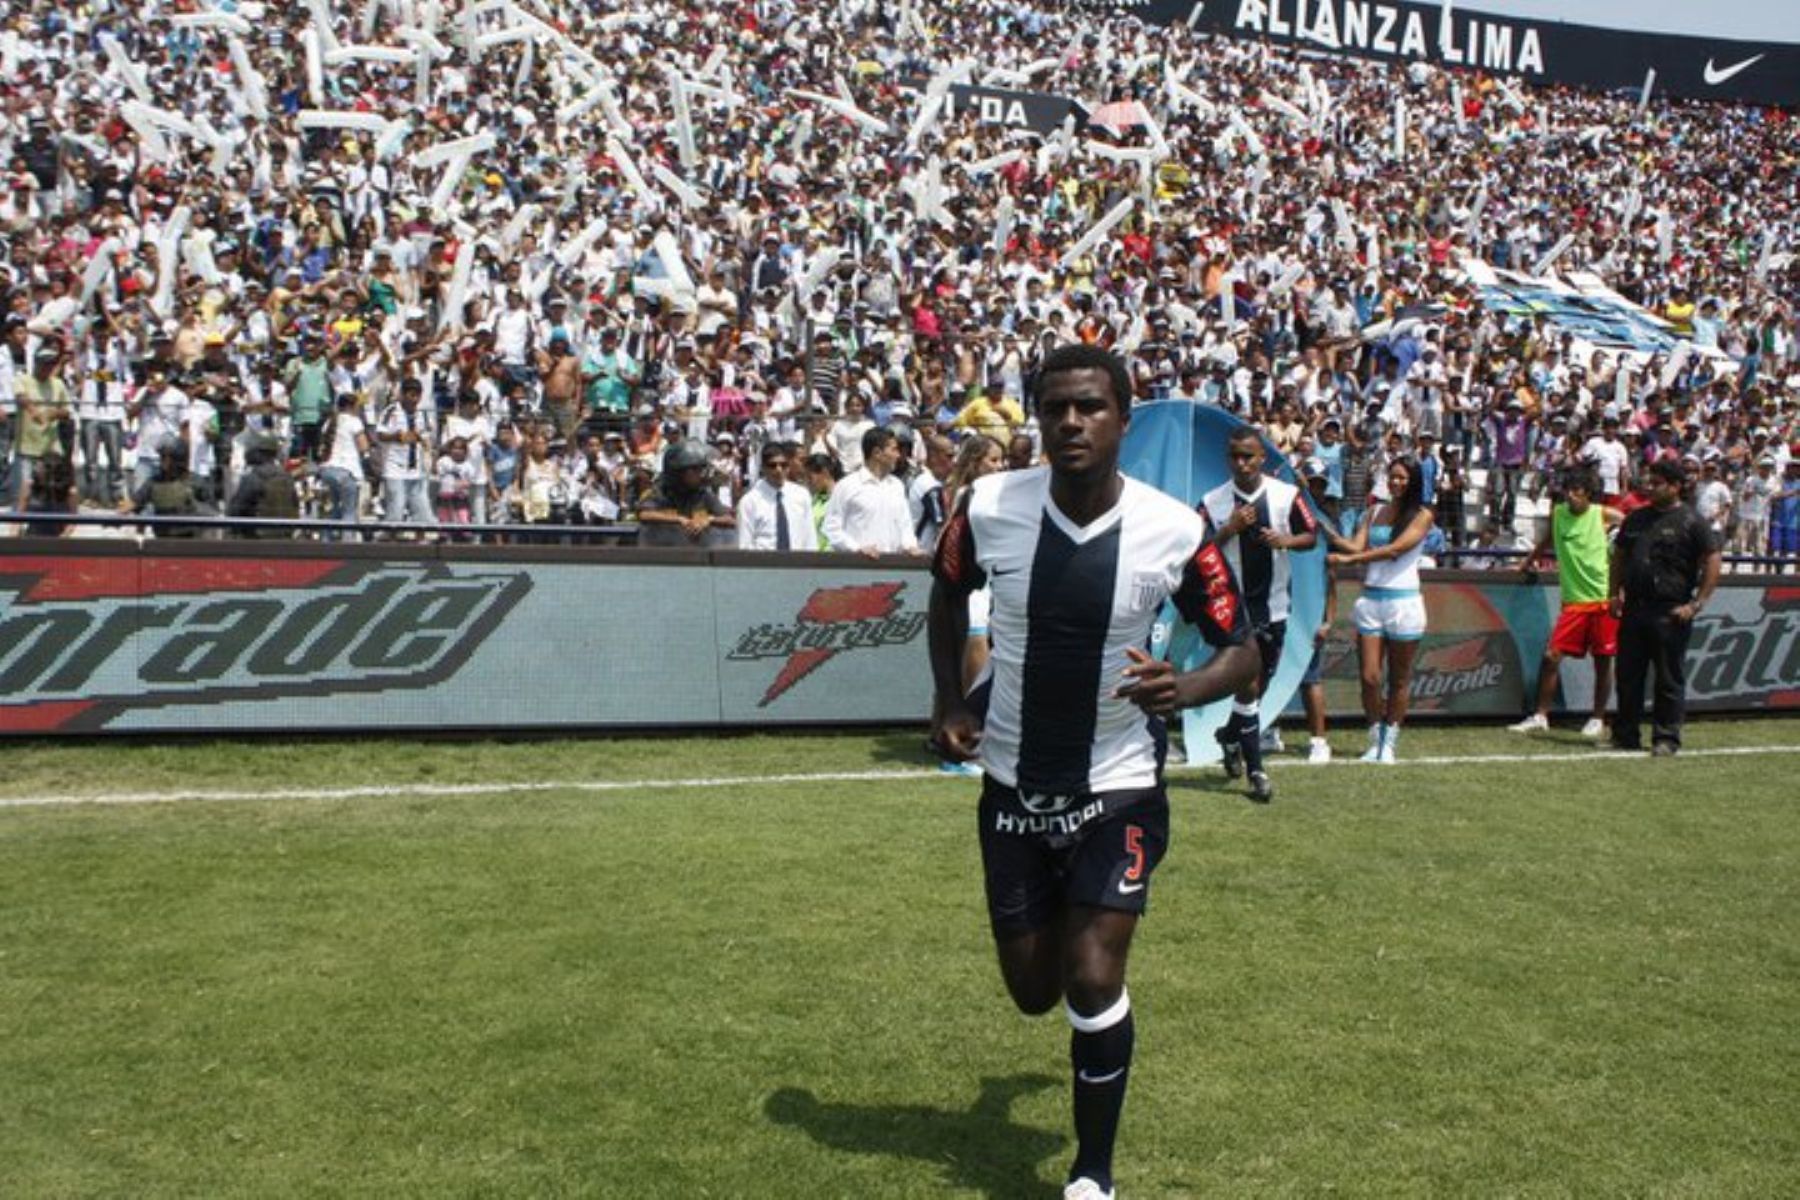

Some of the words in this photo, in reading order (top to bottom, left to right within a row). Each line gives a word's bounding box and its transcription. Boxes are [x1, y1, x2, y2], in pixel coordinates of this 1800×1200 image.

[1234, 0, 1428, 56] ALIANZA
[1439, 10, 1545, 74] LIMA
[1123, 823, 1144, 881] 5
